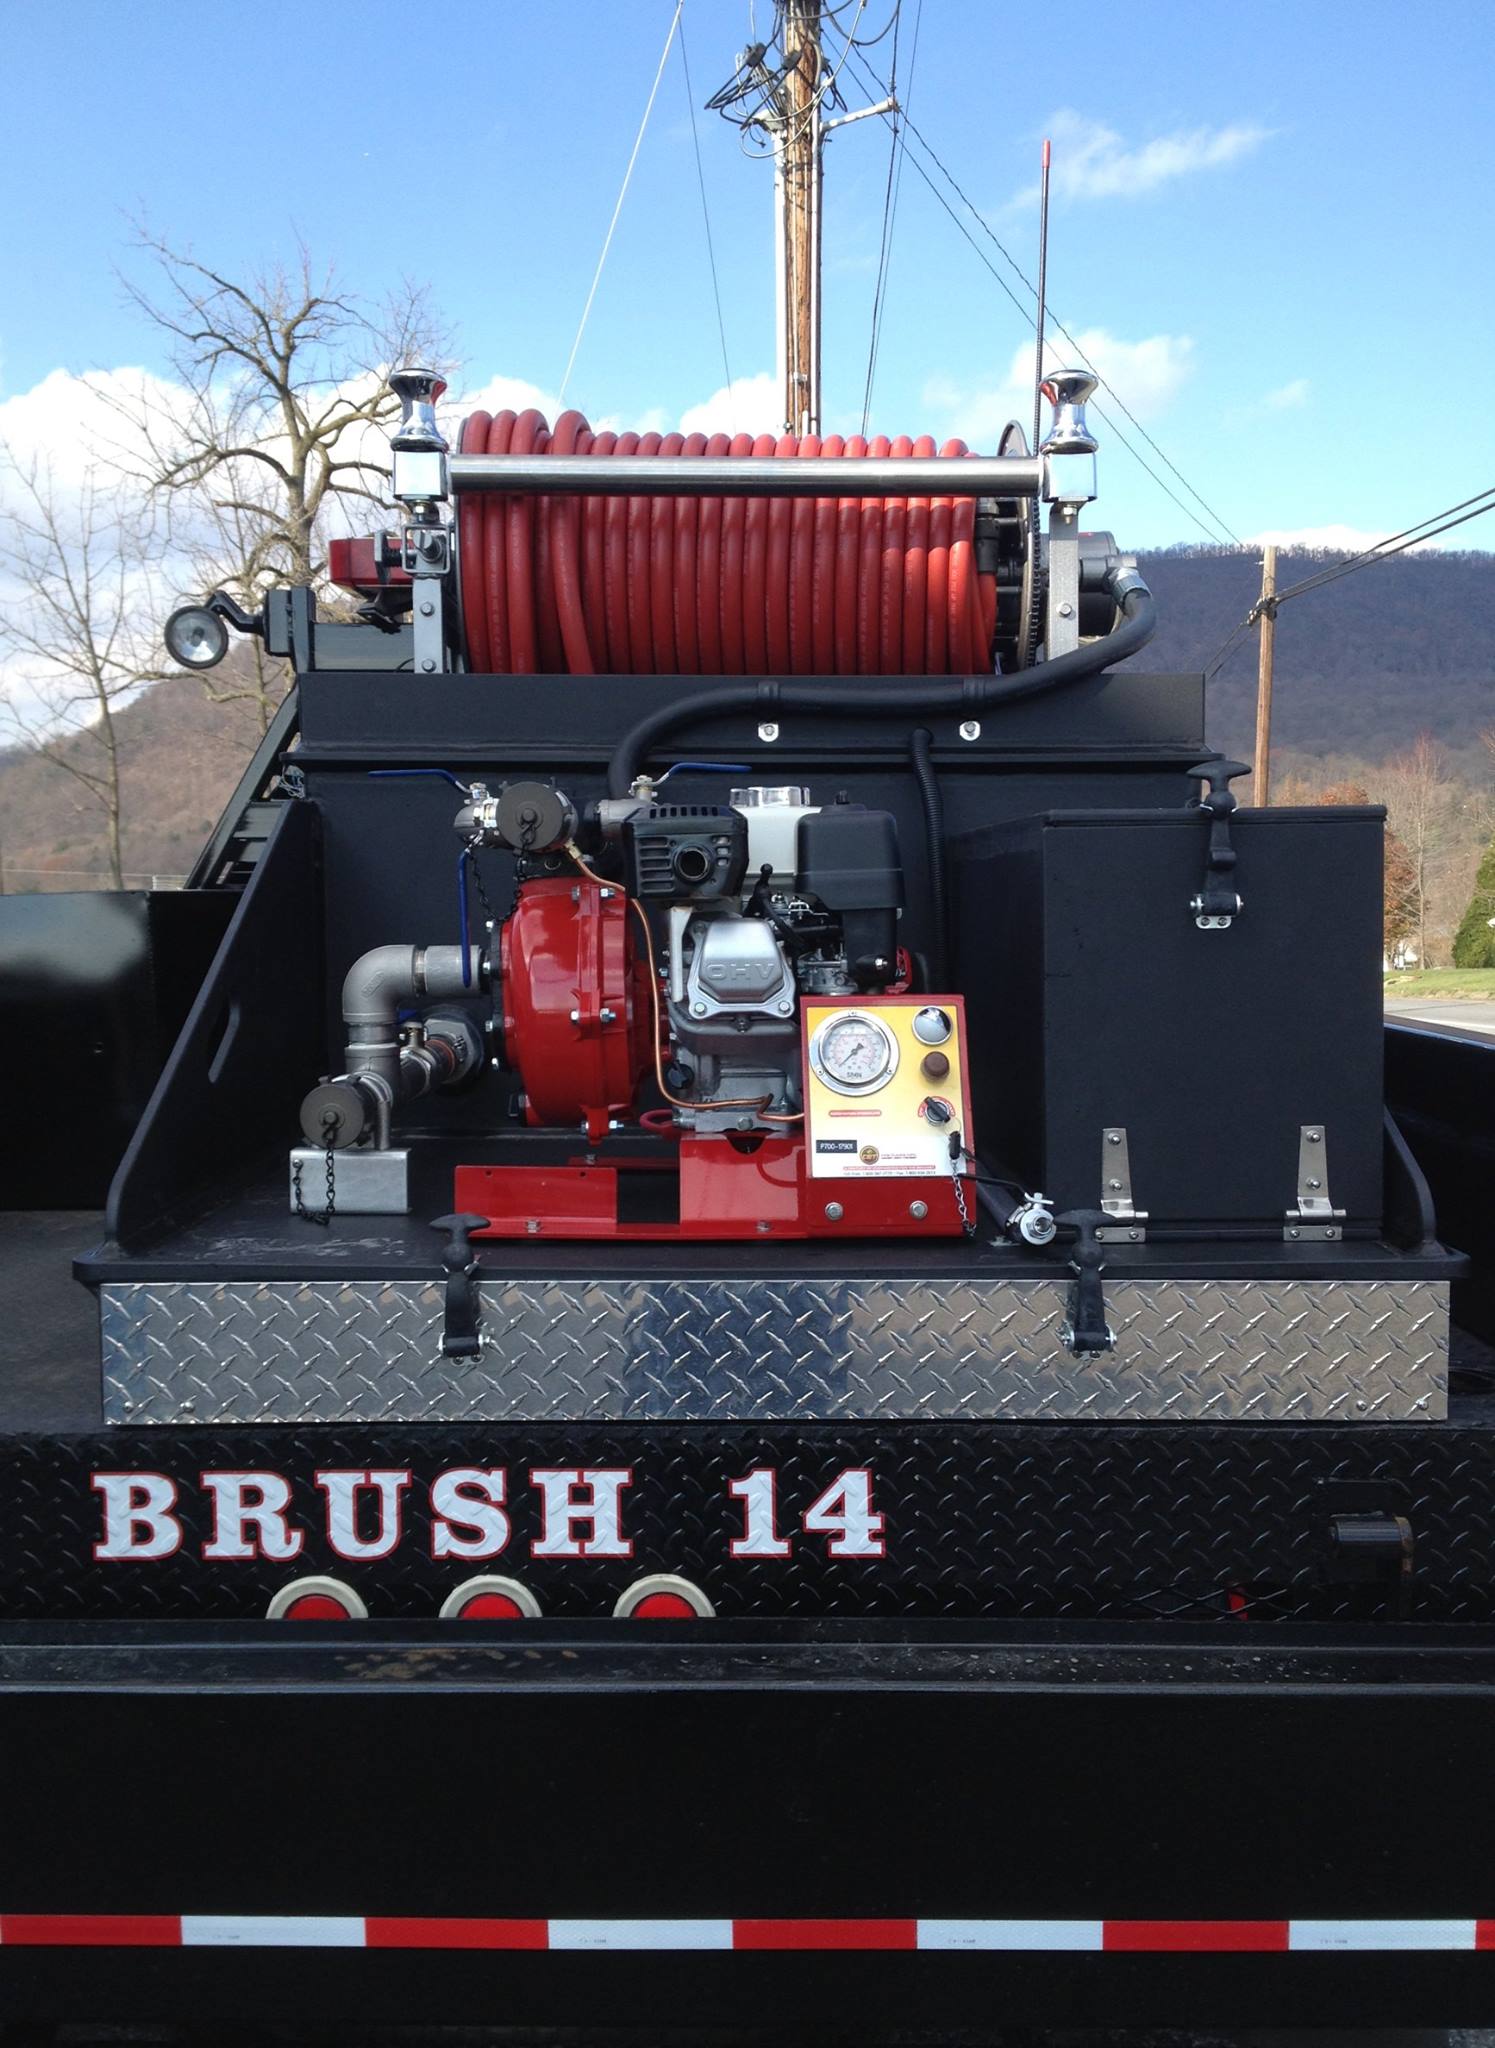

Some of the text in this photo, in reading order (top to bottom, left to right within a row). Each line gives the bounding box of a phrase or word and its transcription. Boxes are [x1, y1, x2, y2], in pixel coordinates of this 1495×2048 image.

[706, 963, 774, 981] OHV
[91, 1468, 887, 1561] BRUSH 14
